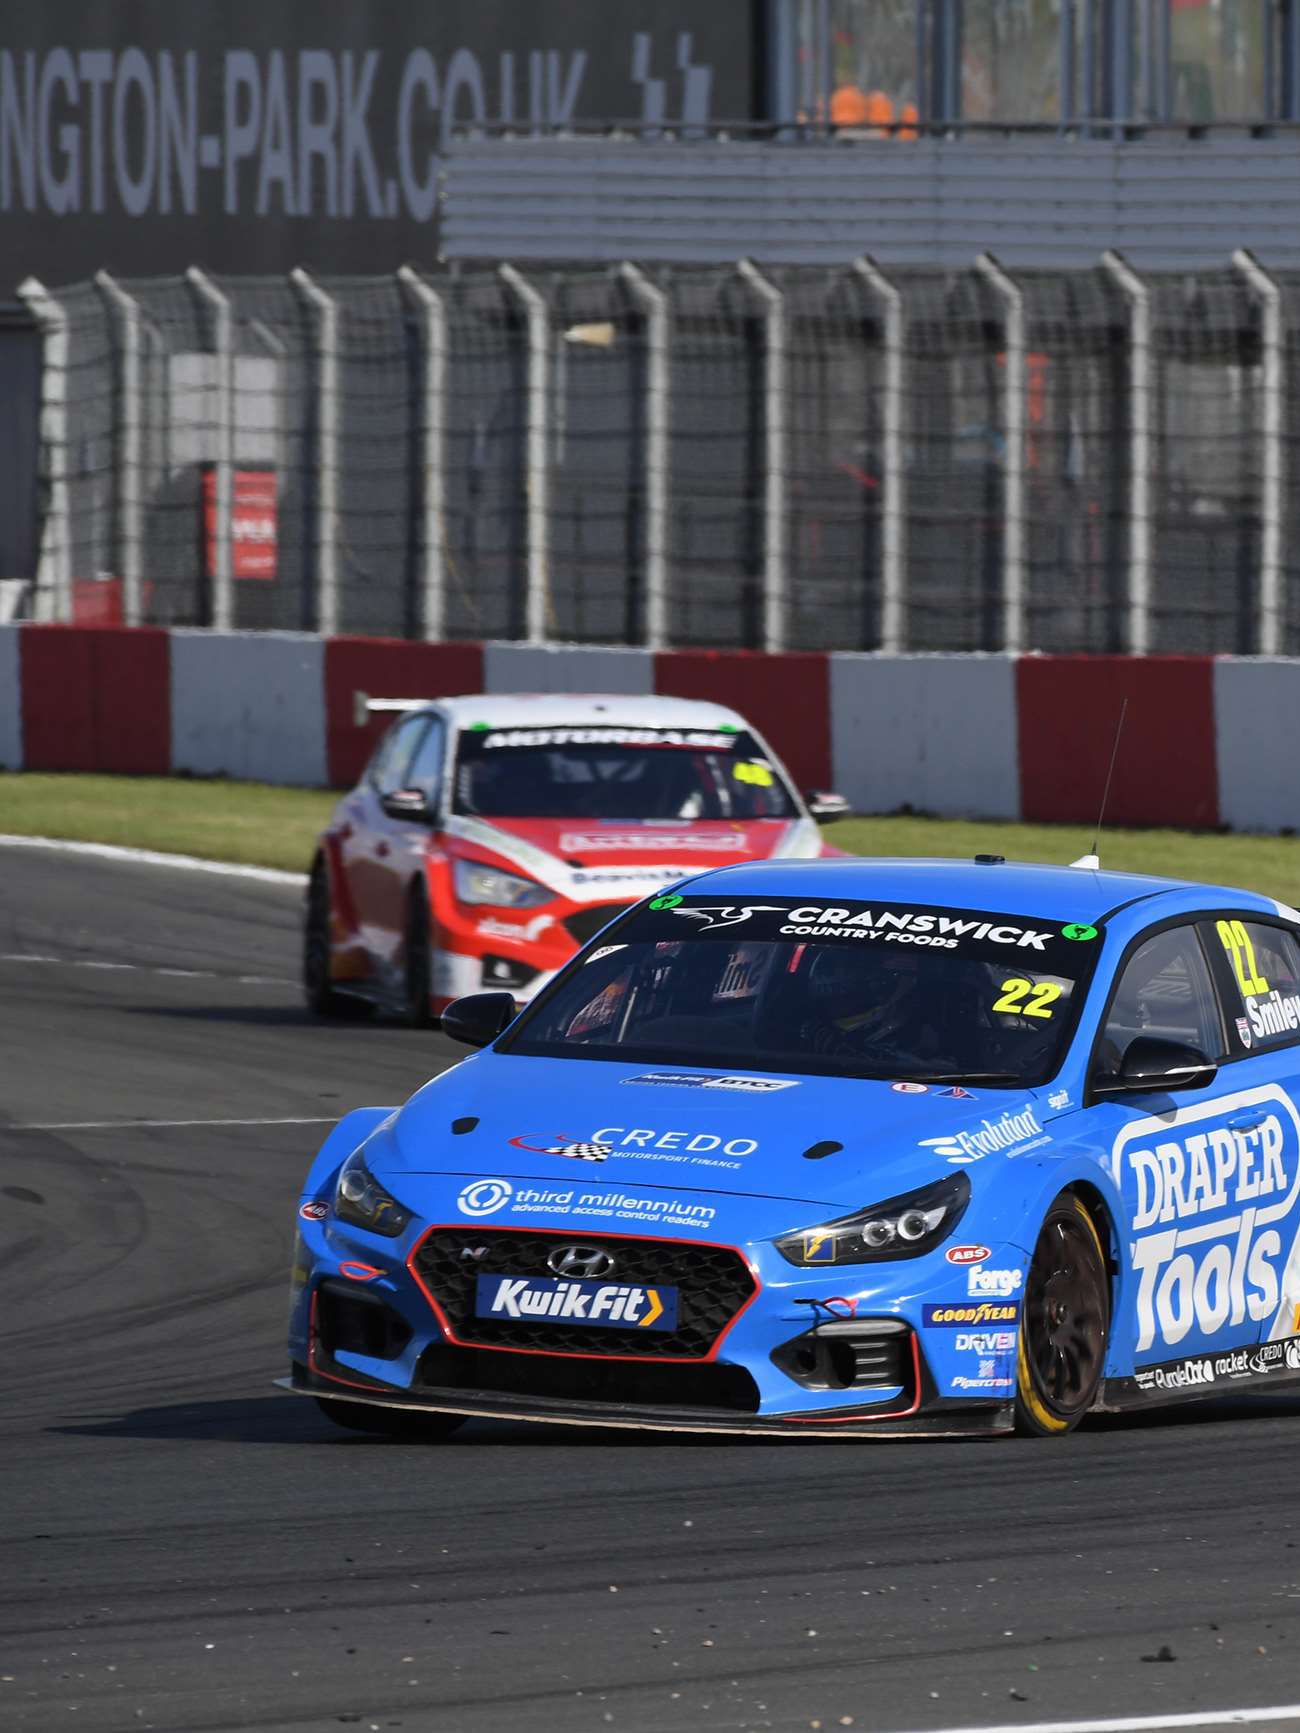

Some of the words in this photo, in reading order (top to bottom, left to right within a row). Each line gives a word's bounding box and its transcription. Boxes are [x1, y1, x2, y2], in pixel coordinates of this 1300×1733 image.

[779, 925, 882, 942] COUNTRY
[884, 932, 959, 949] FOODS
[787, 906, 1056, 951] CRANSWICK
[1216, 920, 1270, 997] 22
[992, 978, 1063, 1018] 22
[590, 1127, 759, 1157] CREDO
[955, 1110, 1043, 1160] Evolution
[610, 1150, 688, 1163] MOTORSPORT
[690, 1157, 742, 1170] FINANCE
[1128, 1114, 1288, 1230] DRAPER
[511, 1203, 576, 1215] advanced
[571, 1208, 613, 1217] access
[615, 1210, 660, 1222] control
[662, 1214, 711, 1228] readers
[515, 1188, 575, 1206] third
[579, 1194, 716, 1219] millennium
[952, 1249, 986, 1261] ABS
[968, 1264, 1022, 1295] Forge
[1131, 1207, 1281, 1352] Tools
[932, 1303, 1017, 1325] GOODYEAR
[1215, 1351, 1249, 1375] rocket
